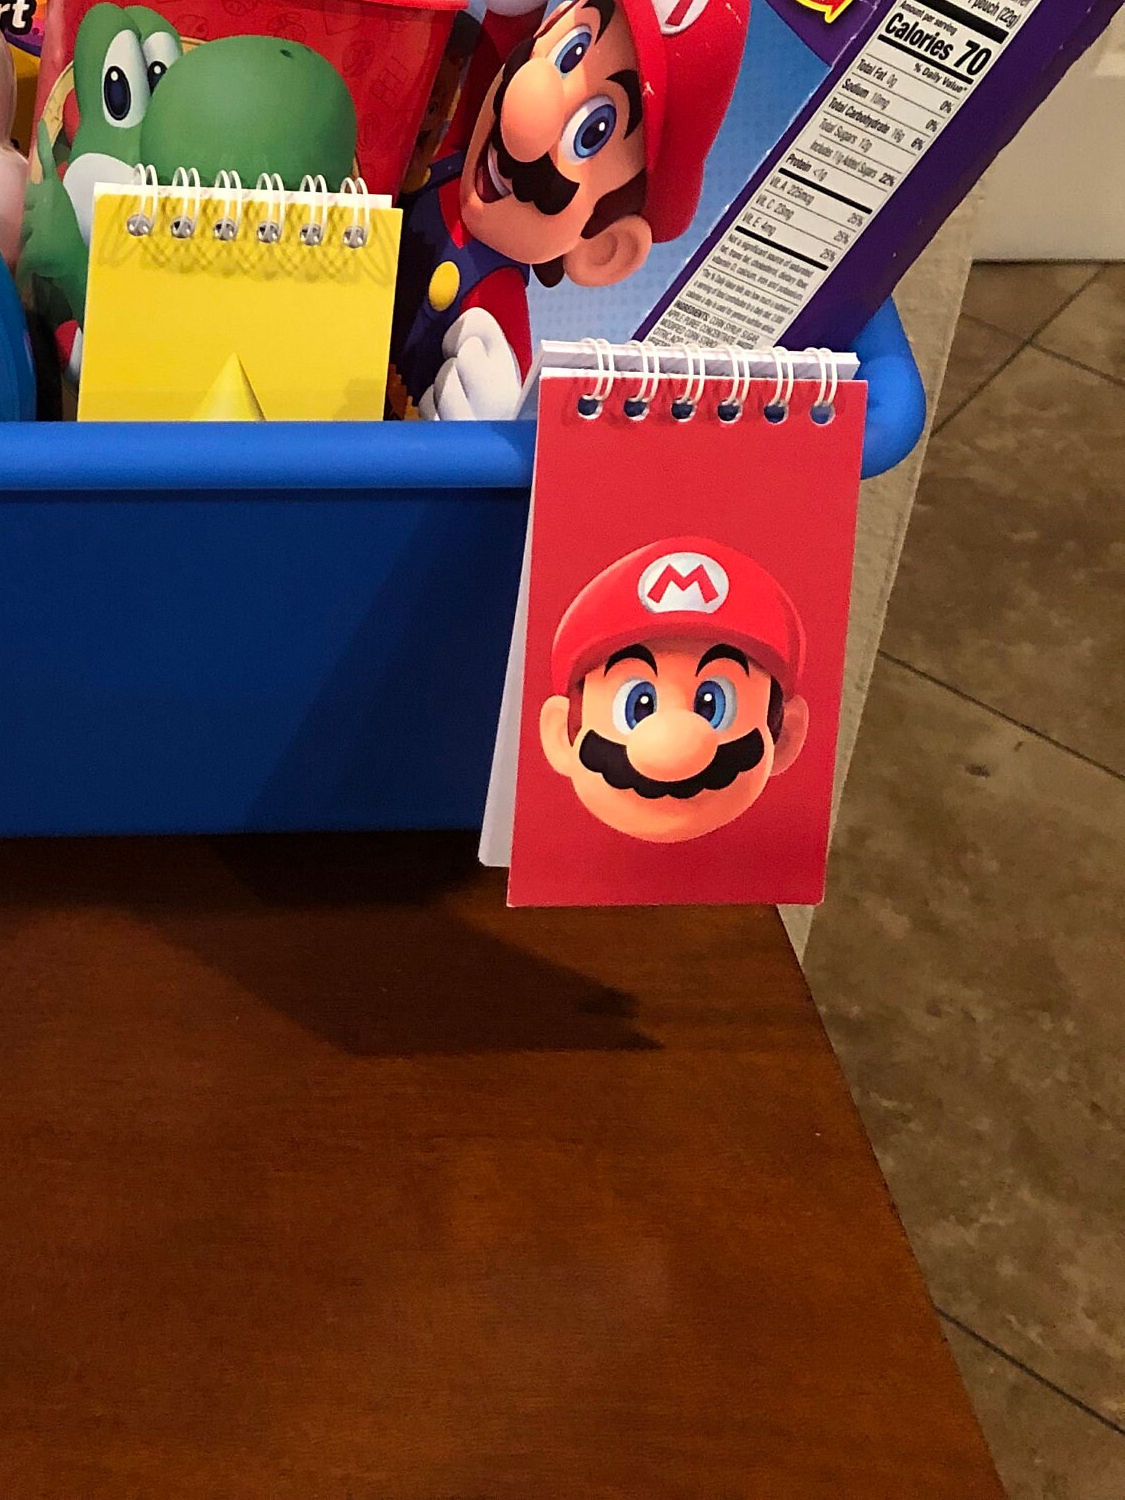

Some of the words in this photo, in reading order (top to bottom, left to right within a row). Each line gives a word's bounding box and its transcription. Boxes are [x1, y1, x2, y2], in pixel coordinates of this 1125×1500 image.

[921, 13, 935, 22] per
[933, 19, 957, 35] serving
[995, 7, 1020, 28] (22g)
[884, 13, 955, 62] Calories
[954, 40, 991, 75] 70
[921, 67, 941, 82] Daily
[841, 78, 868, 97] Sodium
[856, 58, 875, 74] Total
[873, 67, 887, 81] Fat
[939, 100, 951, 113] 0%
[828, 97, 847, 112] Total
[842, 107, 891, 134] Carbohydrate
[785, 153, 811, 171] Protein
[878, 172, 894, 186] 22%
[646, 563, 720, 604] M
